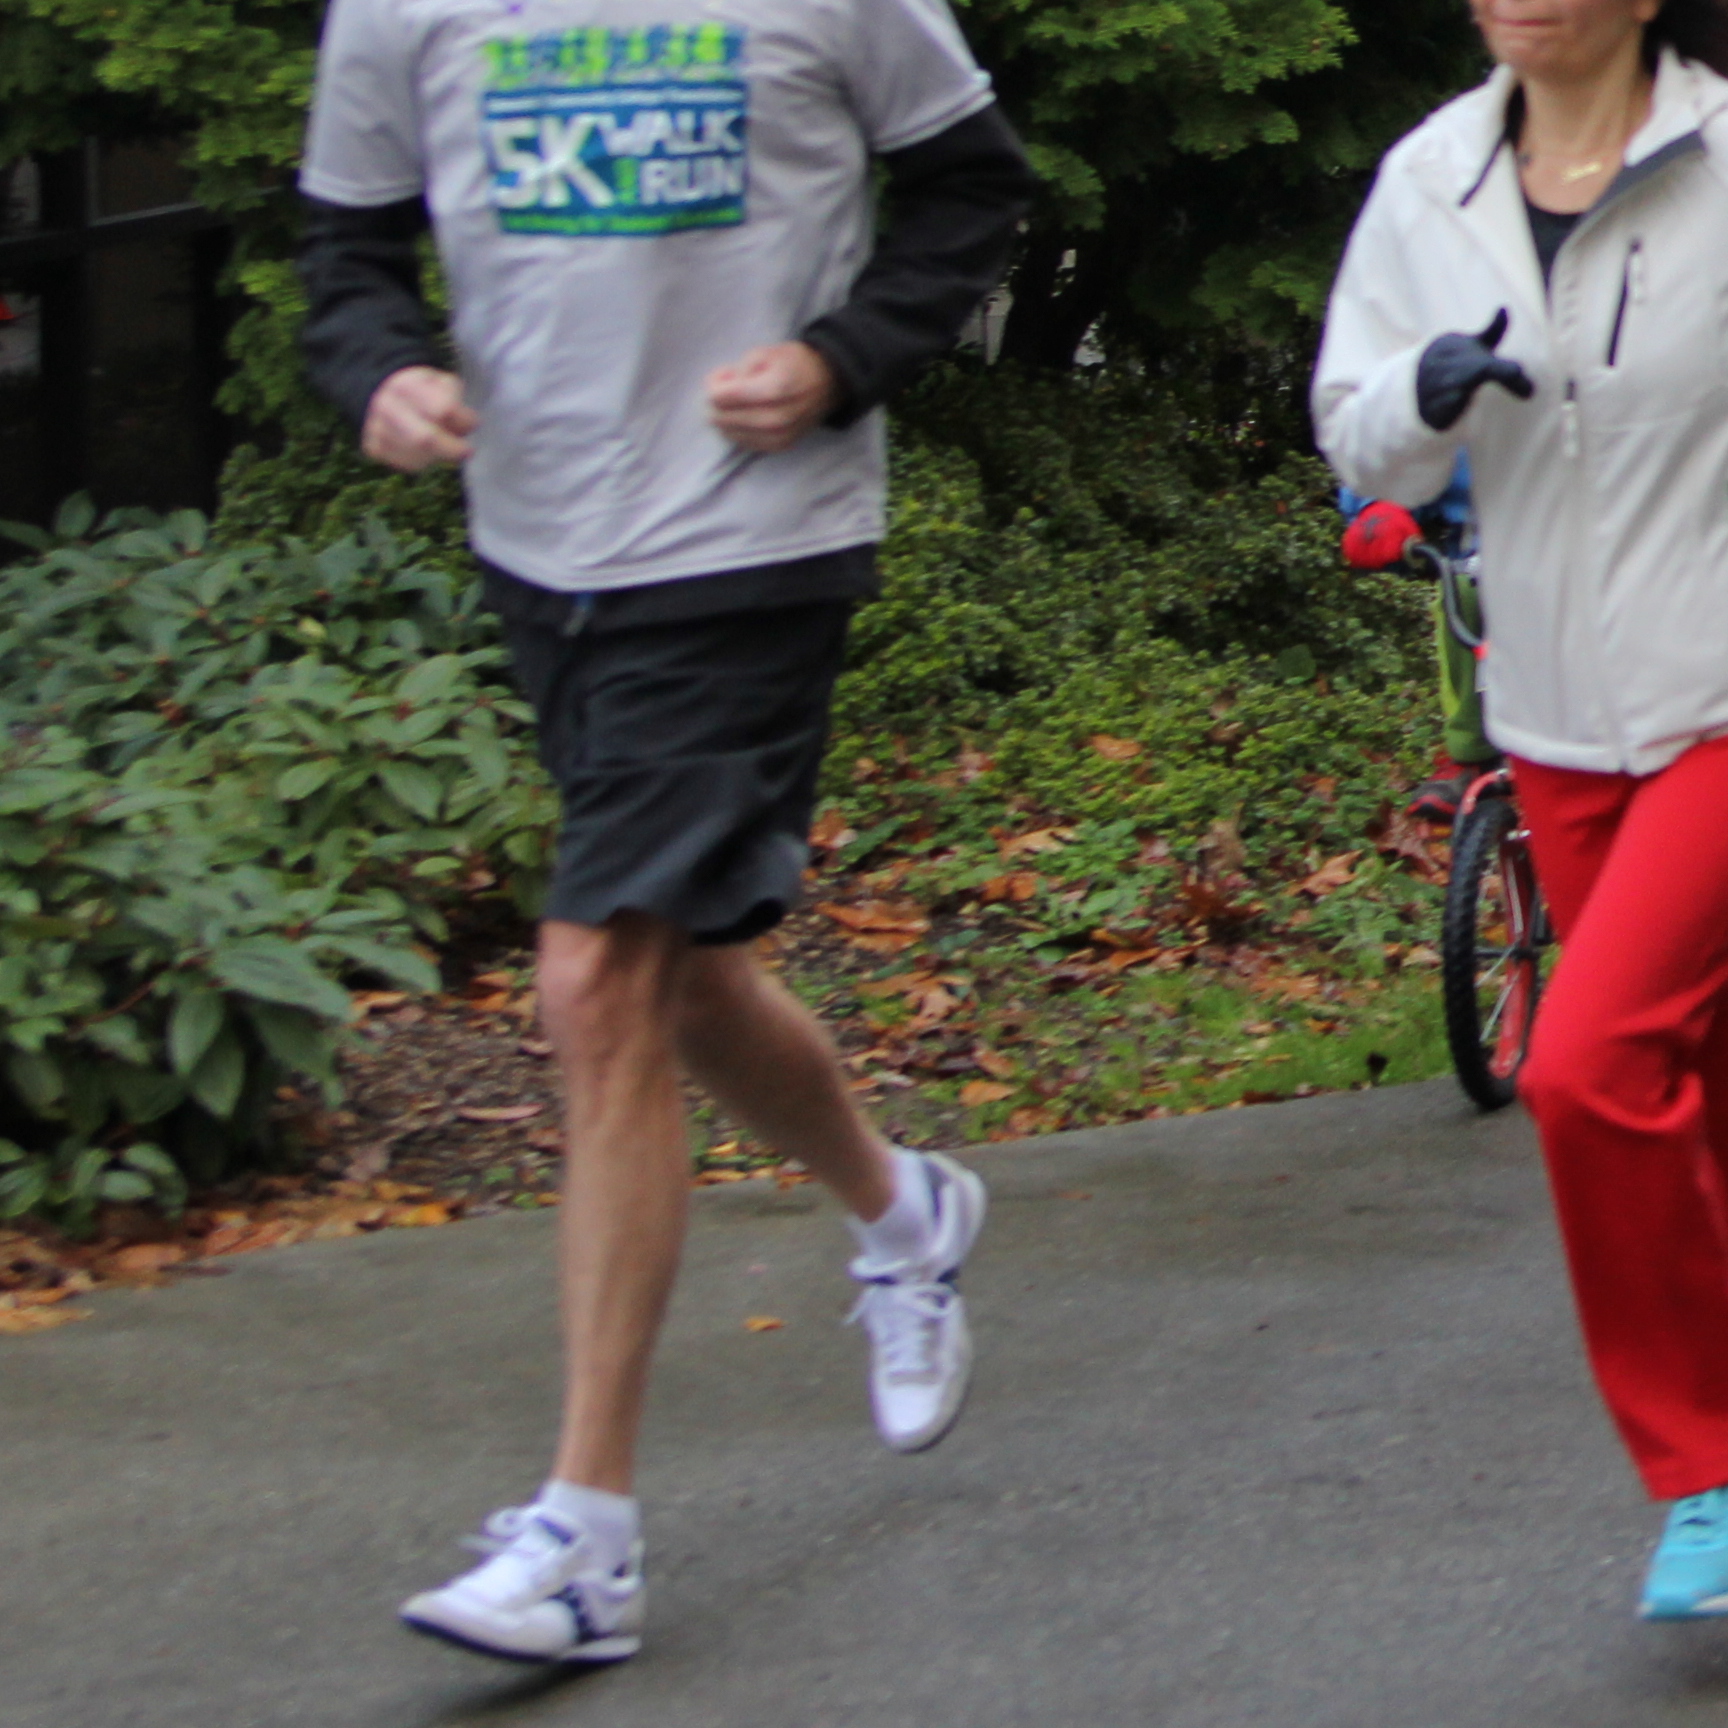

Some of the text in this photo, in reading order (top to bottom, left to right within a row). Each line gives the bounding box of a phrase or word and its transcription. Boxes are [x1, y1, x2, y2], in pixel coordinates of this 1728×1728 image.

[489, 112, 616, 208] 5K
[598, 109, 743, 157] WALK
[638, 156, 743, 205] RUN
